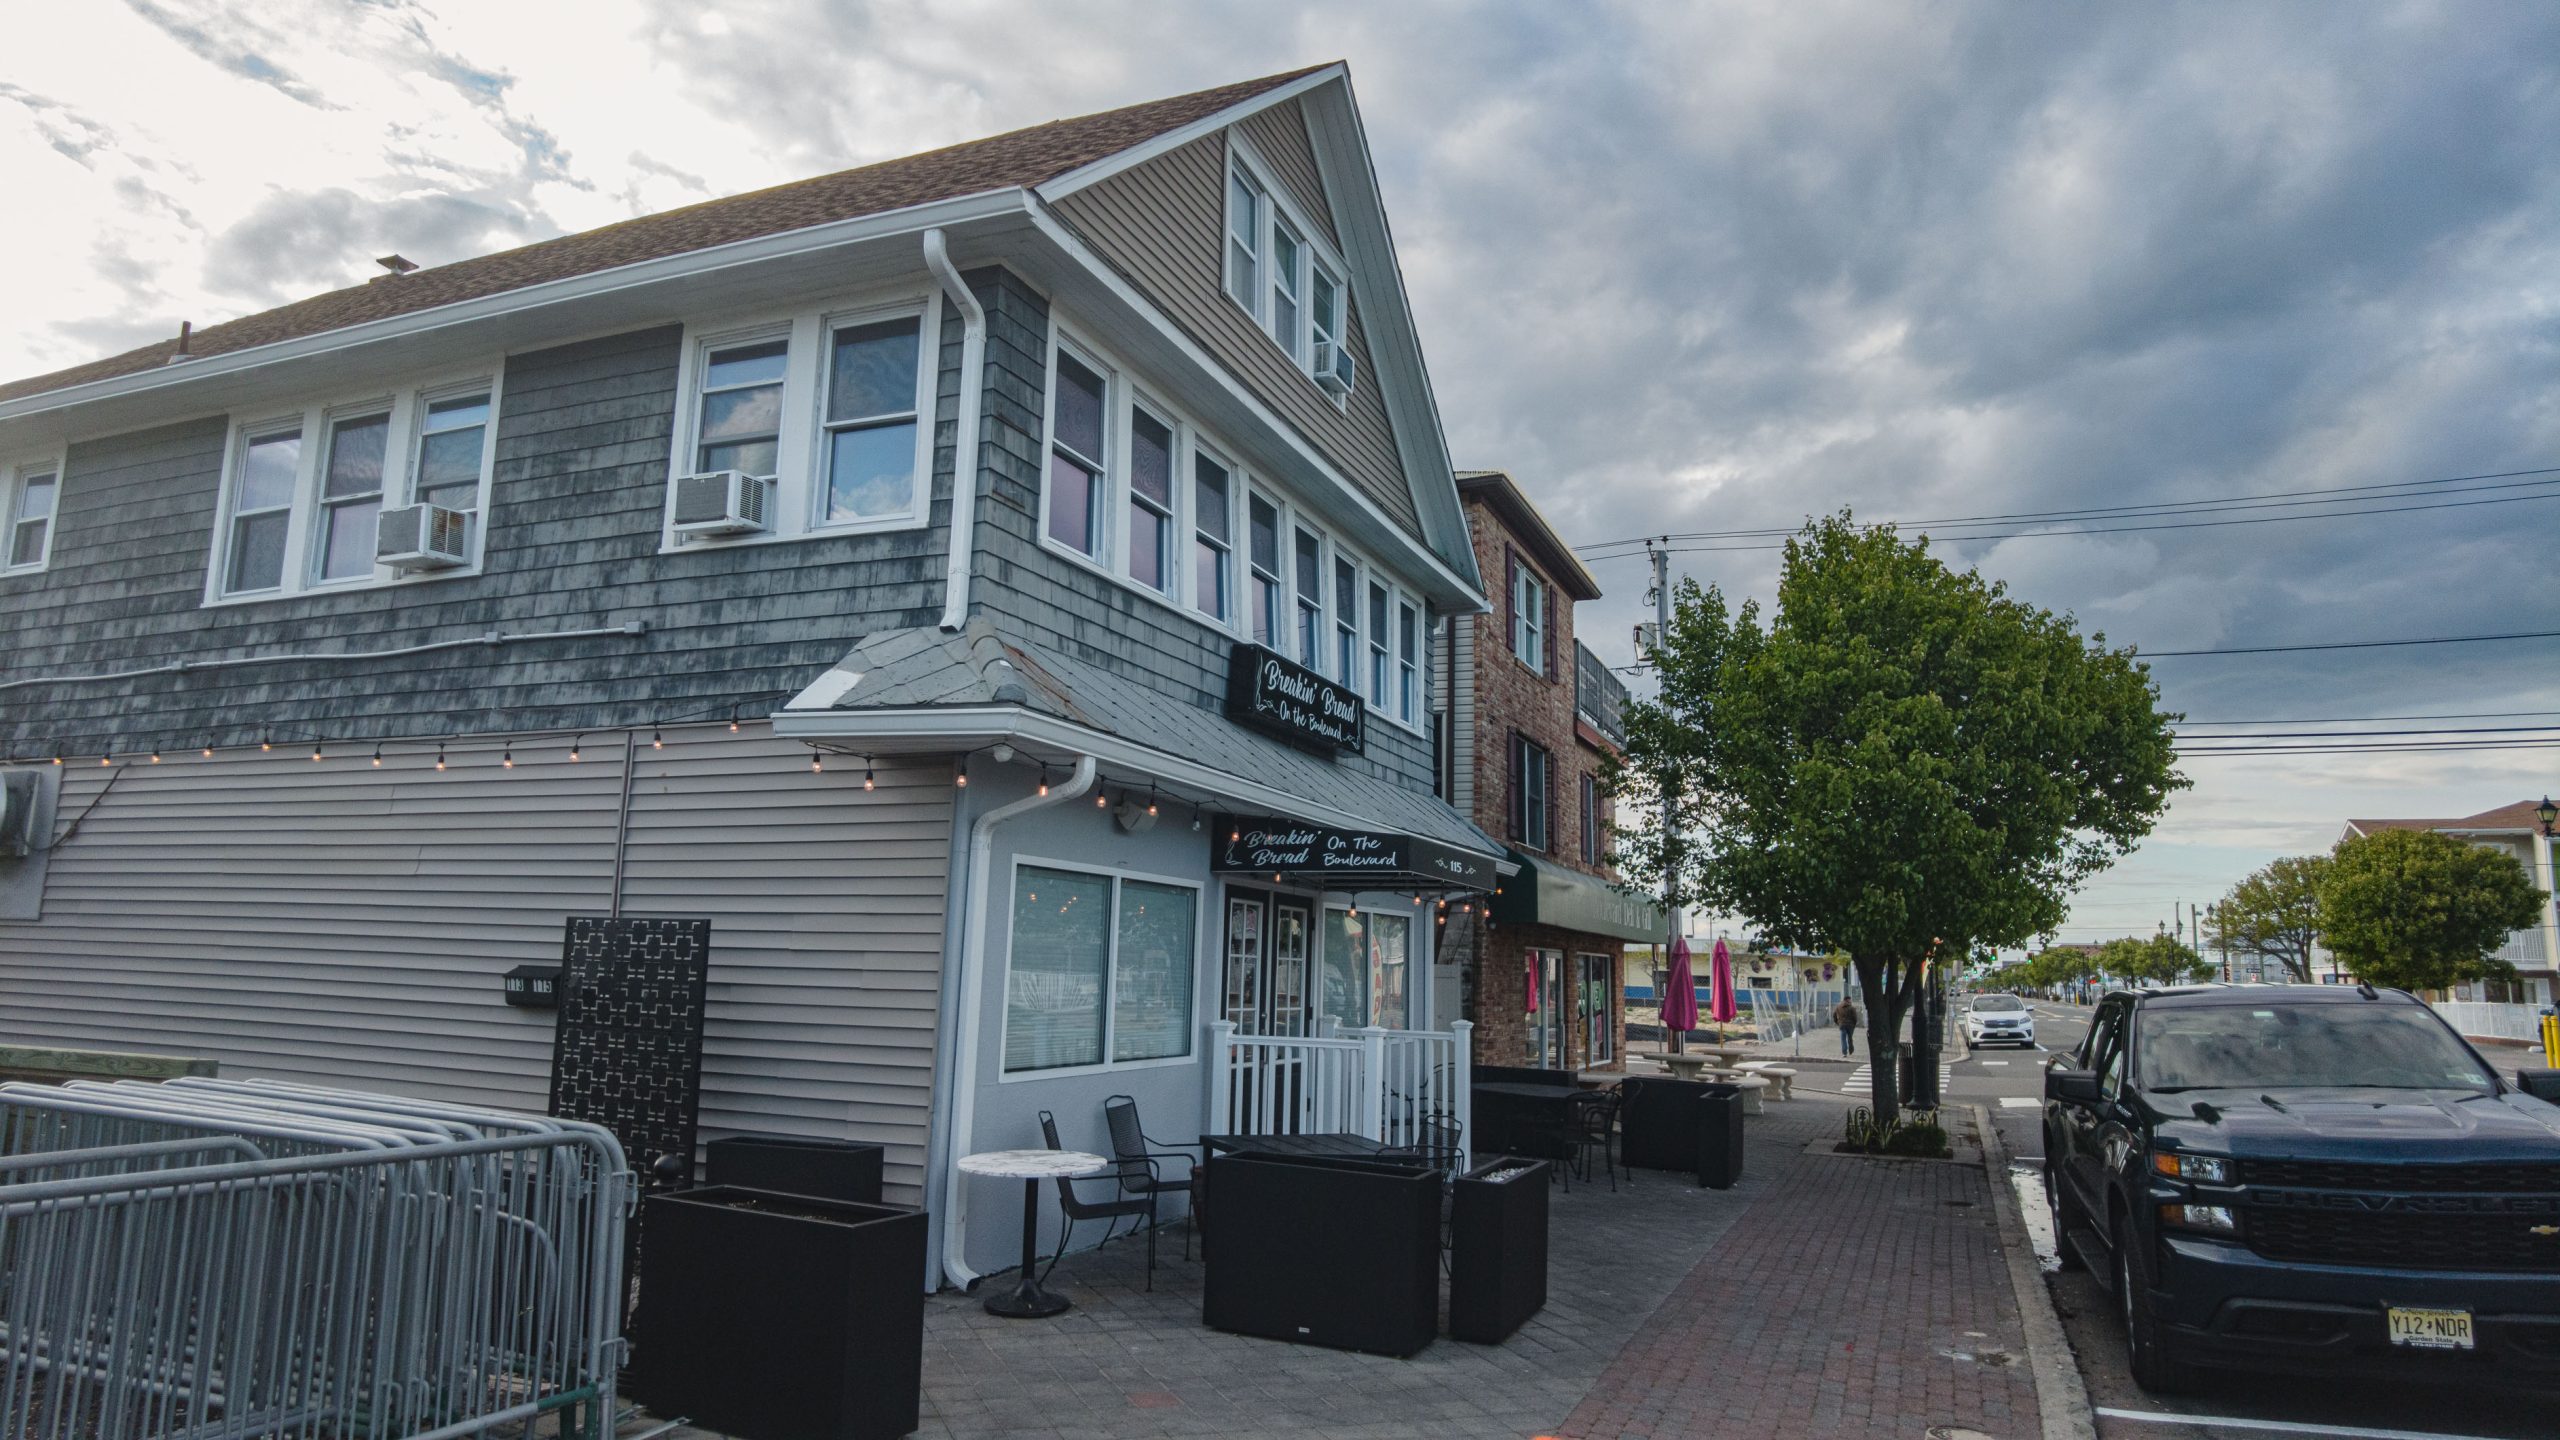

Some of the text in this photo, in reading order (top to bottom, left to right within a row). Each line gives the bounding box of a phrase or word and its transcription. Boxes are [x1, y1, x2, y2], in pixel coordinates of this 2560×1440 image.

[1264, 659, 1356, 723] Breakin' Bread
[1279, 700, 1343, 742] On the Boulevard
[1244, 829, 1382, 850] Breakin' On The
[1251, 848, 1397, 867] Bread Boulevard
[1450, 860, 1463, 874] 115
